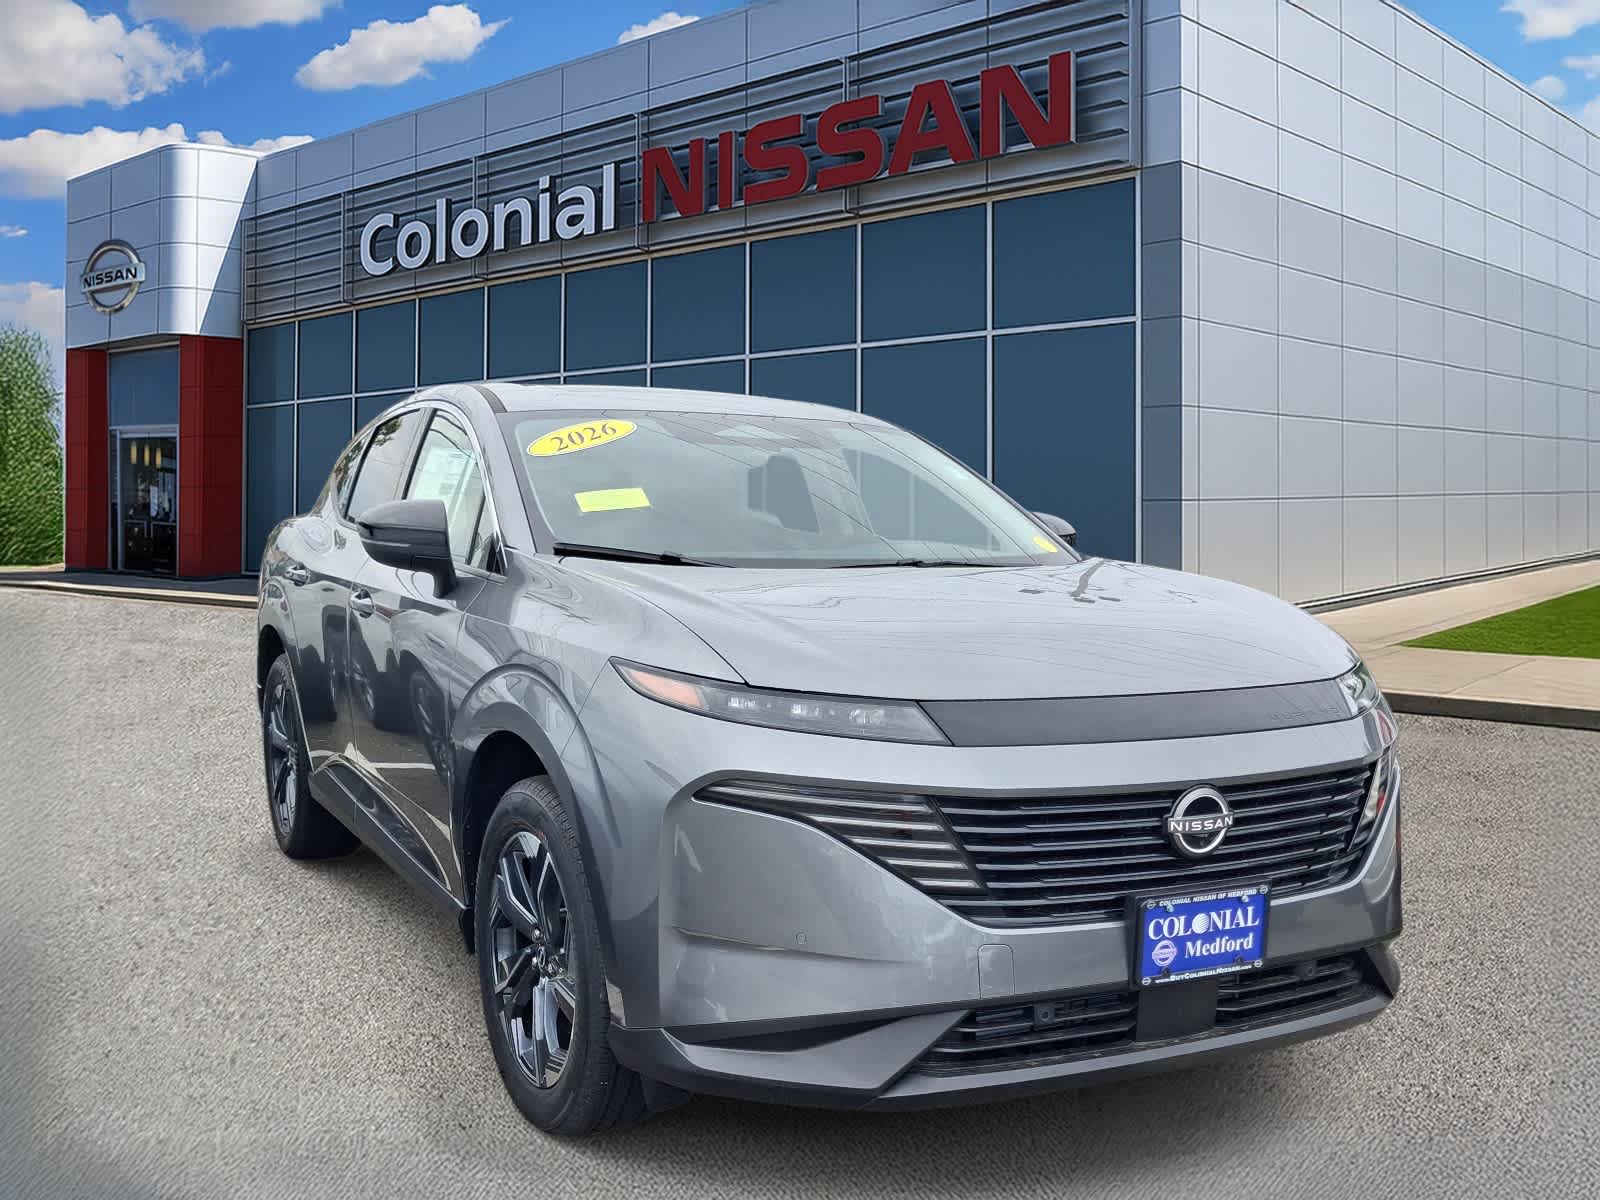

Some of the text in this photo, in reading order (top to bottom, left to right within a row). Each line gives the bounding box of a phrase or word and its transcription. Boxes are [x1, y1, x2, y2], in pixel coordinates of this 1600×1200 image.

[360, 50, 1077, 277] Colonial NISSAN
[83, 266, 138, 289] NISSAN
[550, 422, 617, 451] 2026
[1170, 815, 1233, 832] NISSAN
[1192, 894, 1217, 903] NISSAN
[1217, 892, 1227, 900] OF
[1148, 905, 1260, 940] COLONIAL
[1184, 931, 1254, 959] Medford
